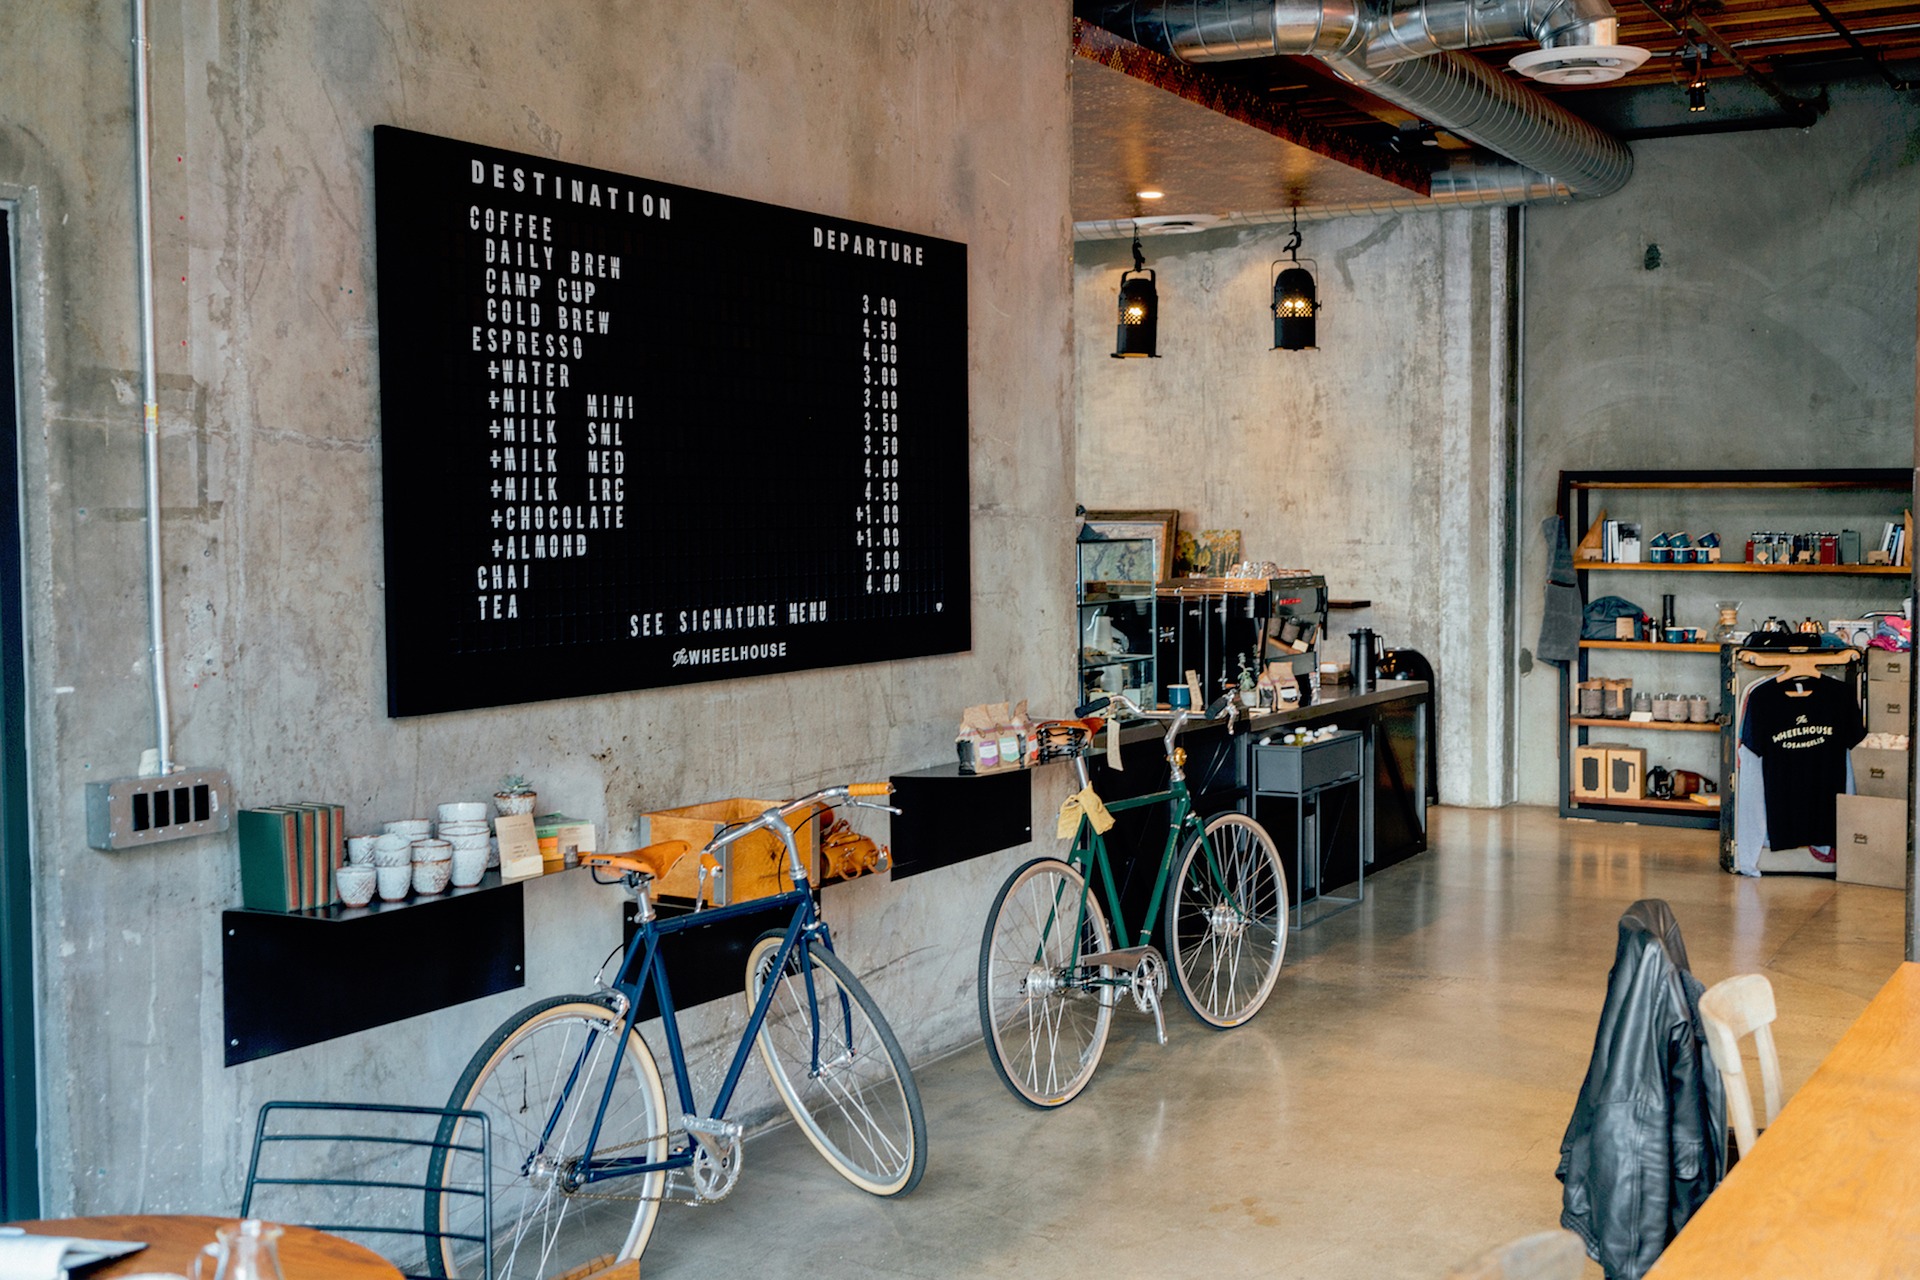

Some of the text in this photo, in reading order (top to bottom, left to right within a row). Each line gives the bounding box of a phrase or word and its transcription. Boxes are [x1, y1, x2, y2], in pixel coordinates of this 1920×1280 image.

[471, 159, 671, 220] DESTINATION
[470, 205, 552, 241] COFFEE
[485, 238, 621, 279] DAILY BREW
[814, 227, 923, 265] DEPARTURE
[485, 268, 596, 304] CAMP CUP
[487, 298, 610, 334] COLD BREW
[863, 295, 896, 317] 3.00
[863, 319, 896, 340] 4.50
[472, 326, 582, 359] ESPRESSO
[863, 342, 897, 364] 4.00
[488, 359, 569, 387] +WATER
[864, 365, 897, 386] 3.00
[488, 388, 633, 419] +MILK MINI
[864, 388, 897, 410] 3.00
[489, 417, 622, 445] +MILK SML
[864, 412, 897, 432] 3.50
[864, 435, 898, 455] 3.50
[490, 447, 624, 474] +MILK MED
[864, 458, 898, 477] 4.00
[491, 477, 624, 502] +MILK LRG
[865, 482, 898, 501] 4.50
[491, 506, 624, 530] +CHOCOLATE
[856, 504, 898, 524] +1.00
[492, 534, 587, 560] +ALMOND
[856, 528, 899, 547] +1.00
[866, 551, 899, 571] 5.00
[478, 564, 529, 589] CHAI
[866, 573, 899, 593] 4.00
[478, 594, 517, 620] TEA
[630, 600, 827, 638] SEE SIGNATURE MENU
[672, 642, 787, 668] The WHEELHOUSE
[1772, 726, 1833, 743] WHEELHOUSE
